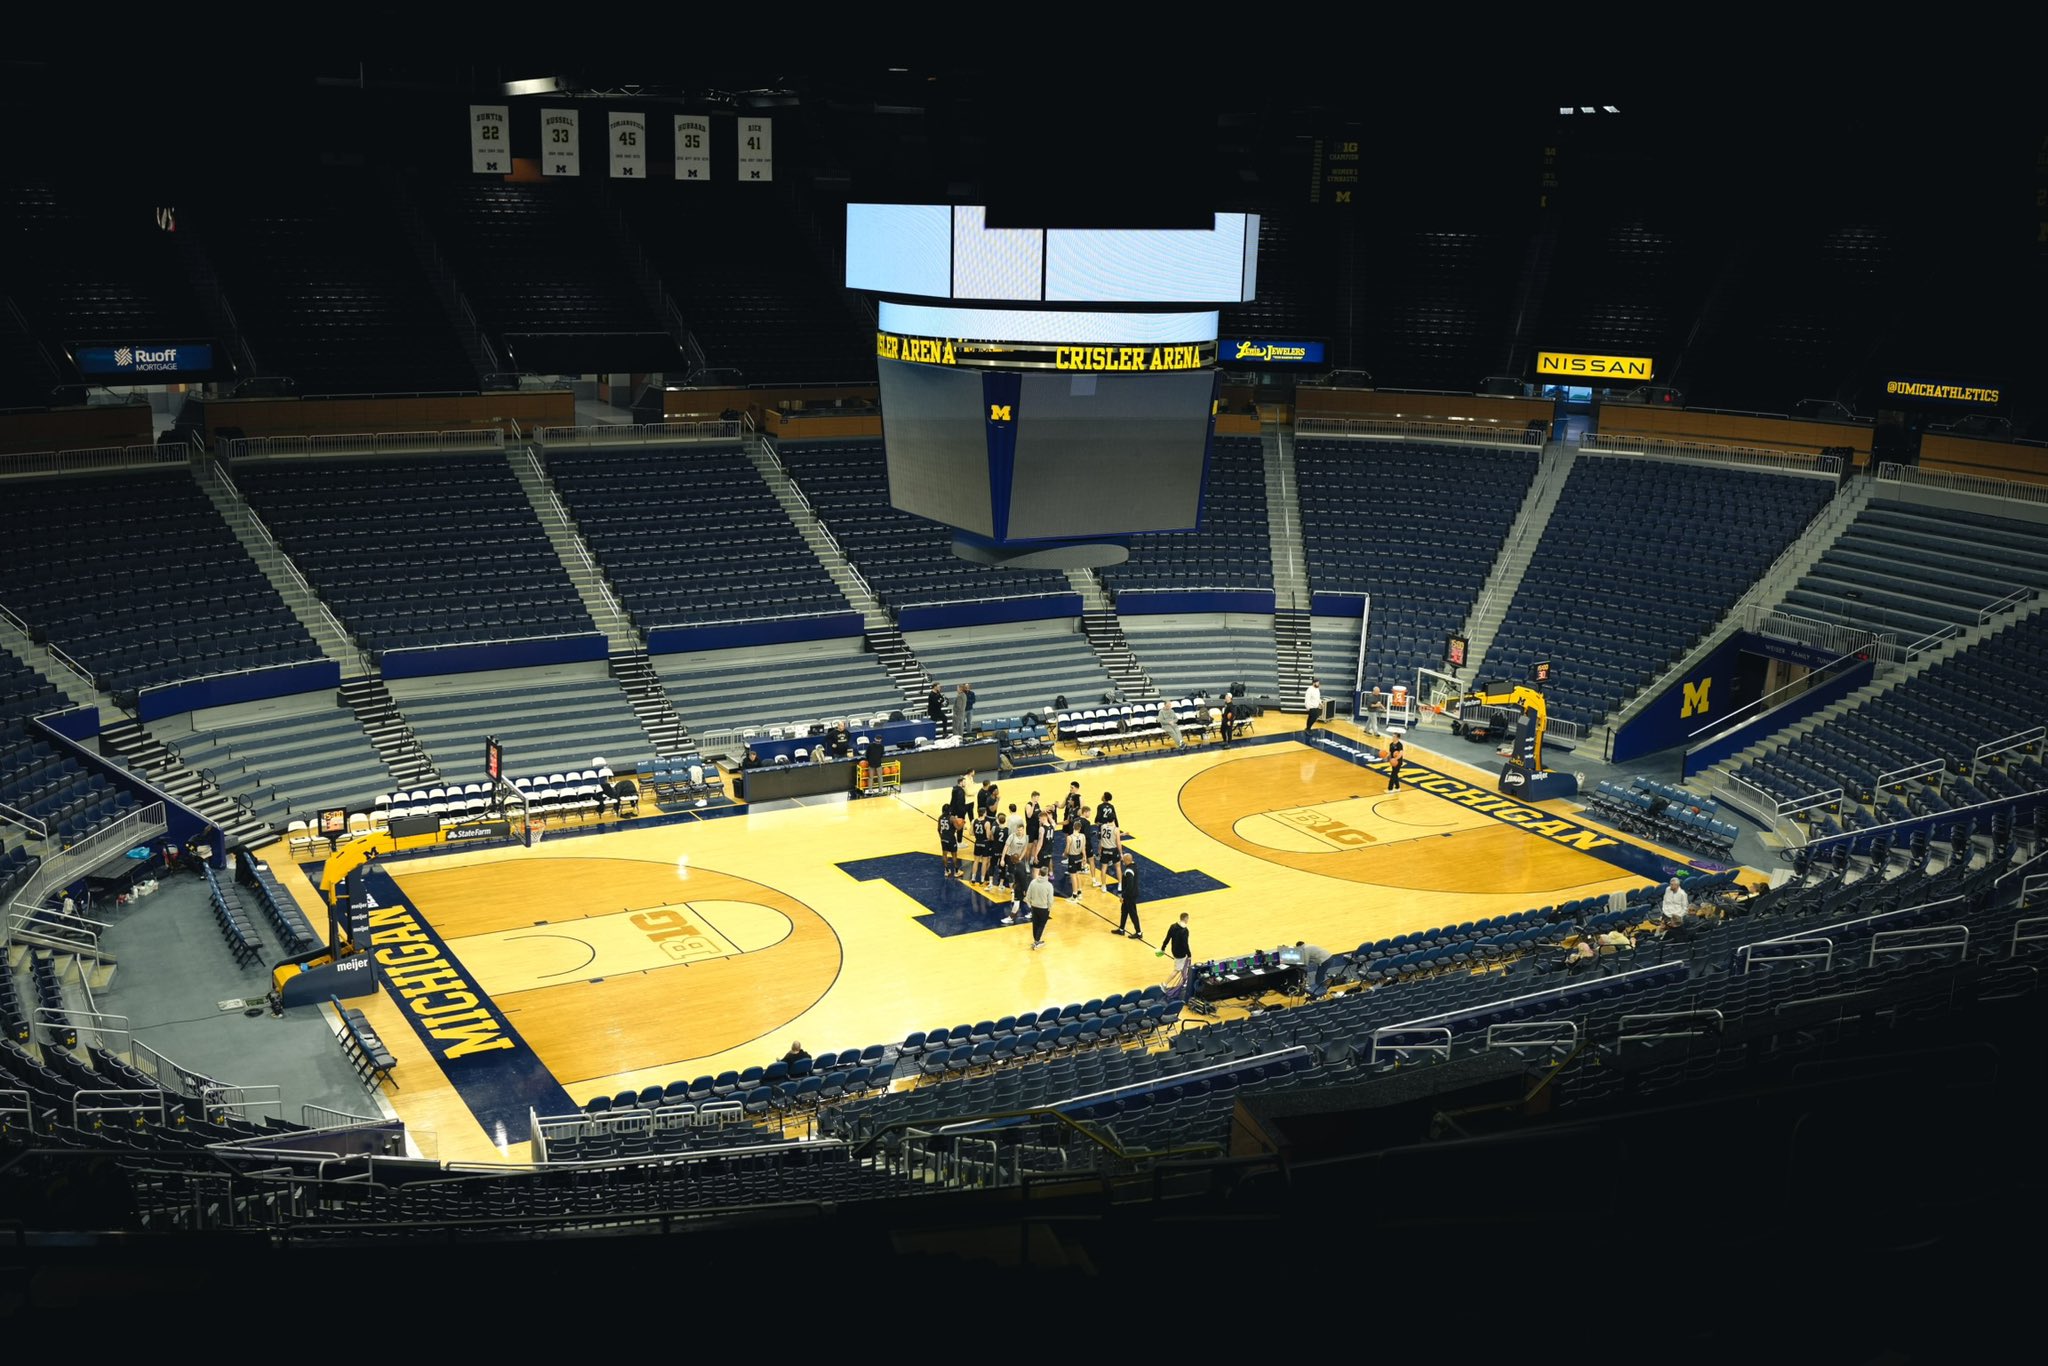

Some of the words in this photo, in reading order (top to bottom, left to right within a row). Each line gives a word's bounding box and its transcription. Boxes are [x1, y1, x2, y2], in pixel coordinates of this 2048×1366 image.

[546, 116, 574, 127] RUSSELL
[482, 126, 499, 140] 22
[552, 129, 569, 143] 33
[619, 132, 636, 146] 45
[684, 134, 701, 148] 35
[747, 136, 761, 150] 41
[487, 162, 498, 170] M
[556, 165, 567, 173] M
[623, 167, 633, 175] M
[687, 169, 698, 177] M
[1335, 191, 1352, 203] M
[135, 349, 177, 362] Ruoff
[901, 338, 957, 365] ARENA
[1056, 346, 1145, 370] CRISLER
[1150, 346, 1201, 370] ARENA
[136, 363, 178, 371] MORTGAGE
[1543, 357, 1645, 375] NISSAN
[1887, 381, 1999, 402] @UMICHATHLETICS
[991, 404, 1012, 421] M
[1680, 677, 1712, 719] M
[1531, 771, 1548, 780] meijer
[1366, 758, 1619, 850] MICHIGAN
[940, 819, 950, 831] 55
[974, 823, 984, 834] 23
[1278, 809, 1378, 845] BIG
[998, 832, 1004, 842] 2
[1102, 828, 1112, 839] 25
[363, 846, 379, 860] M
[629, 910, 722, 960] BIG
[336, 958, 369, 971] meijer
[368, 905, 515, 1060] MICHIGAN
